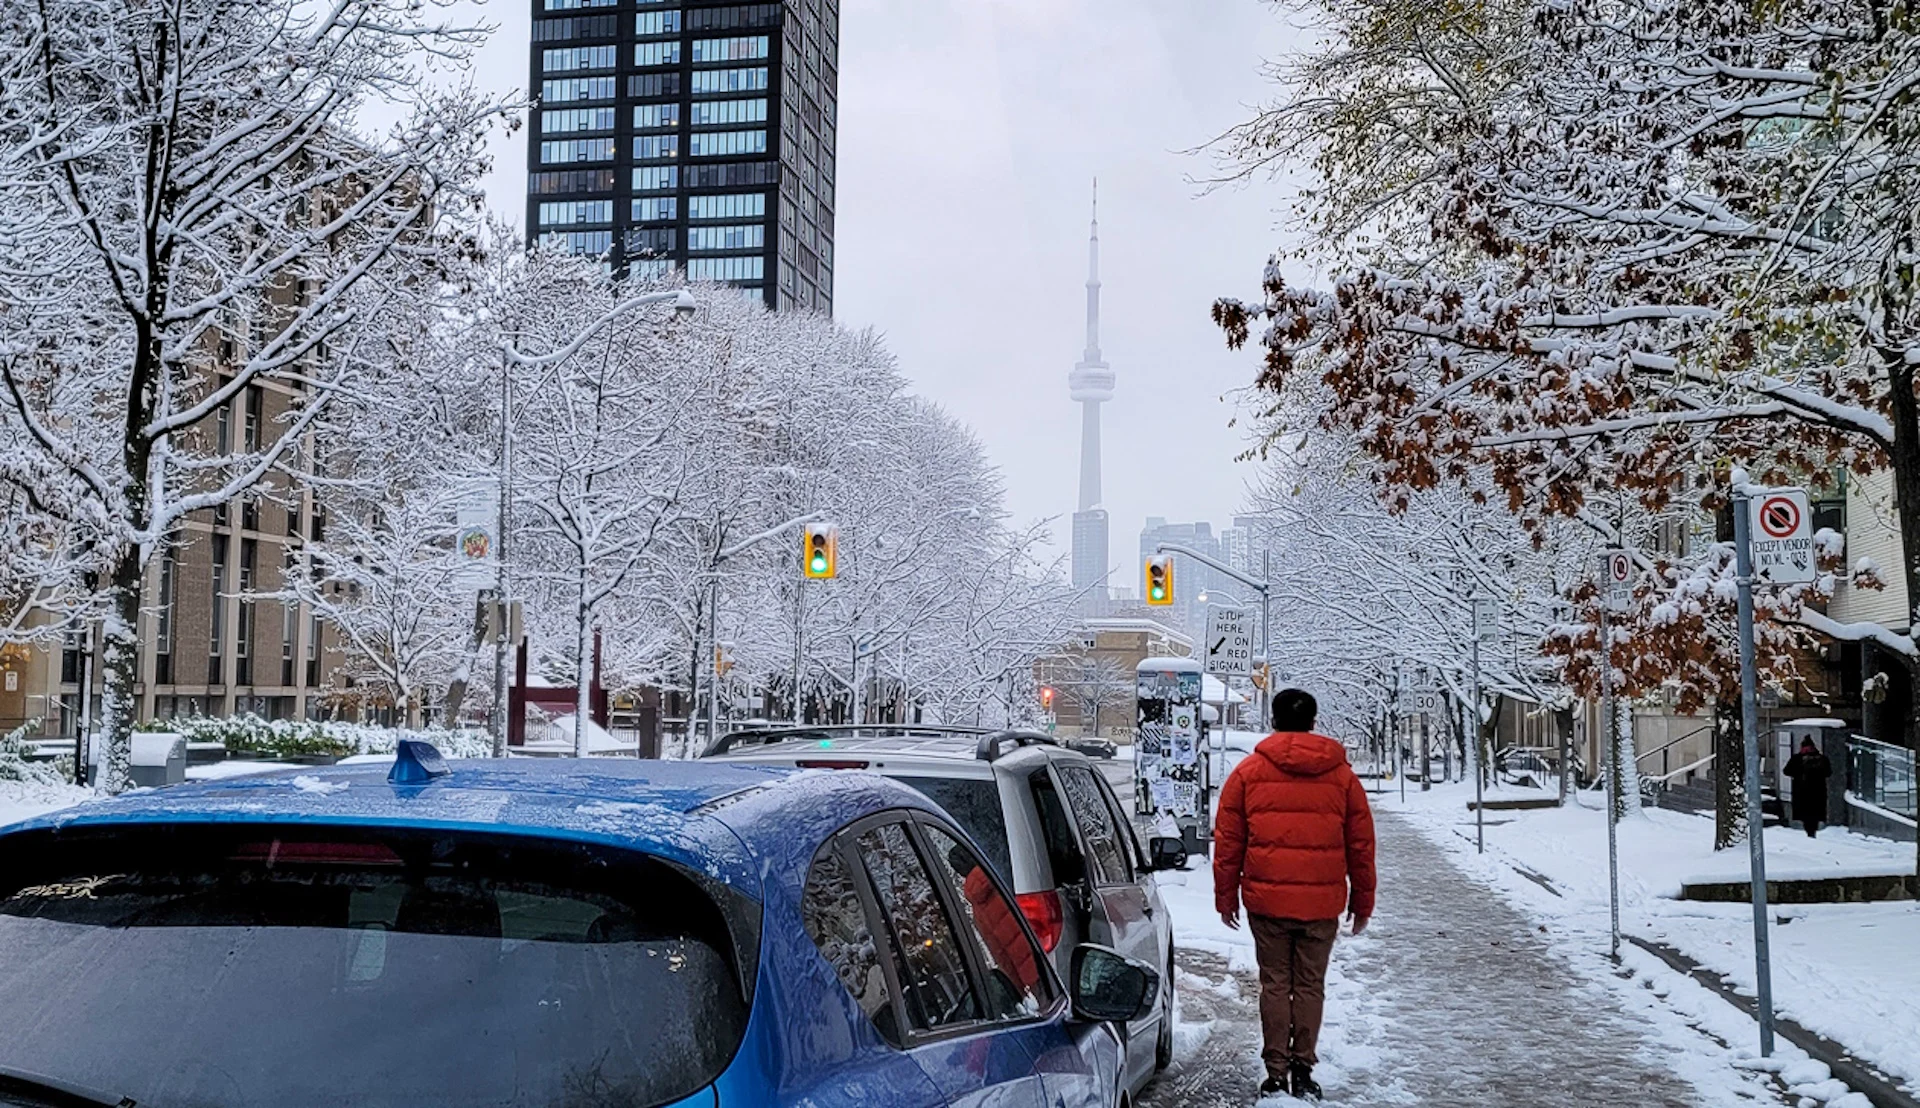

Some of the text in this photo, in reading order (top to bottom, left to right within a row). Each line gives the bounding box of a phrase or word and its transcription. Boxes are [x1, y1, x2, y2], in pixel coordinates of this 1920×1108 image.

[1755, 538, 1810, 552] EXCEPT VENDOR
[1216, 623, 1244, 634] HERE
[1234, 637, 1249, 646] ON
[1227, 649, 1248, 659] RED
[1209, 659, 1246, 672] SIGNAL
[1416, 696, 1434, 708] 30
